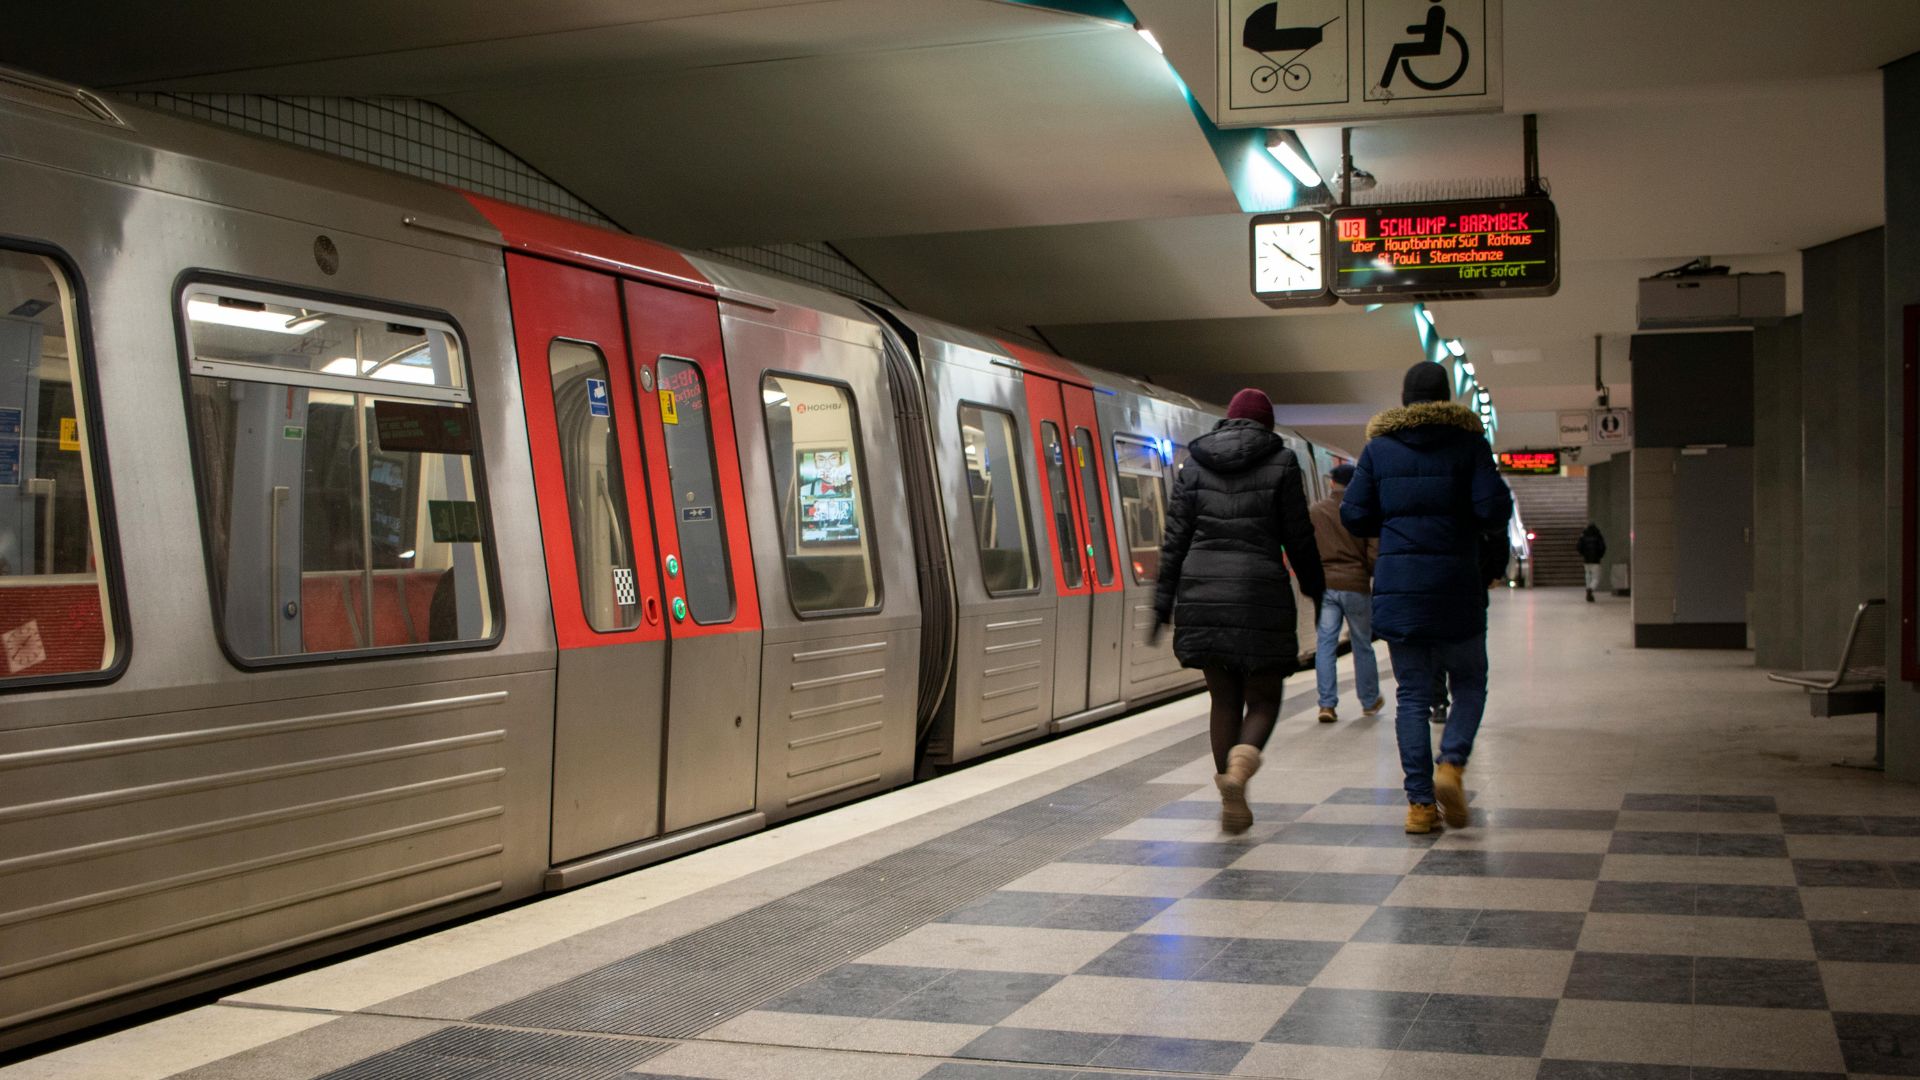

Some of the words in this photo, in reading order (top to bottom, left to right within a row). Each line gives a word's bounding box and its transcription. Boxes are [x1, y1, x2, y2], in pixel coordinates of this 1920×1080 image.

[1343, 221, 1361, 238] U3
[1379, 216, 1448, 237] SCHLUMP
[1459, 212, 1529, 233] BARMBEK
[1351, 239, 1376, 253] über
[1487, 232, 1533, 247] Rathaus
[1429, 249, 1504, 264] Sternschanze
[1459, 264, 1488, 279] fährt
[1490, 264, 1527, 278] sofort
